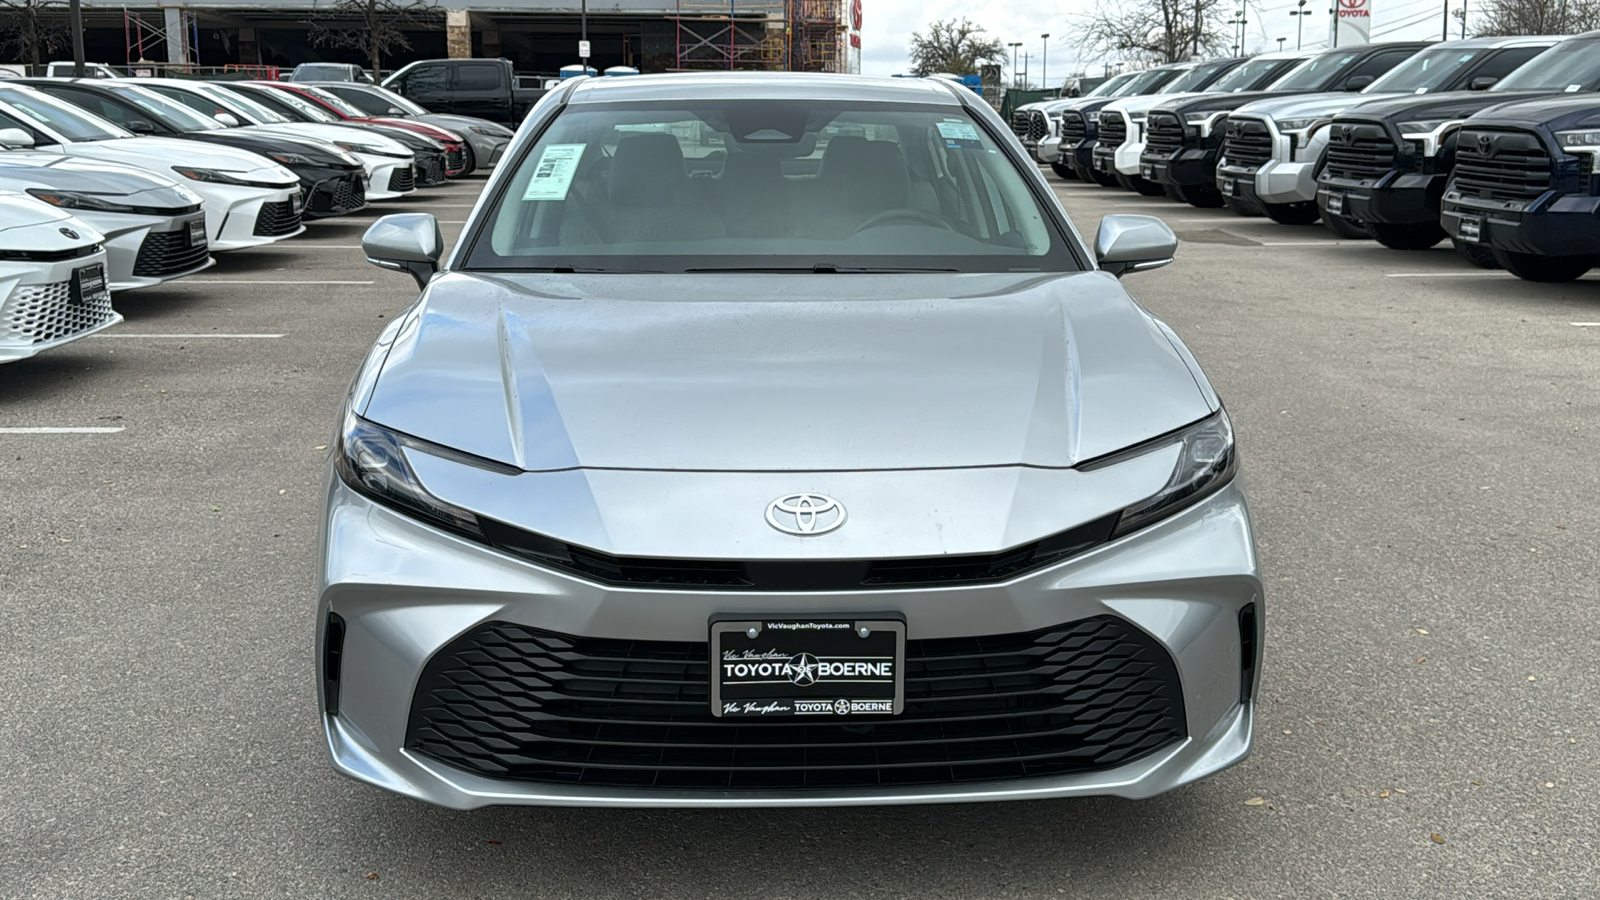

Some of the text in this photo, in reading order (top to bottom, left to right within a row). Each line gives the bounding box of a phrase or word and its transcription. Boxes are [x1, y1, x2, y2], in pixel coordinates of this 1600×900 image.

[1337, 9, 1370, 18] OYOTA
[767, 622, 850, 631] VicVaughanToyota.com
[722, 648, 788, 661] Vic Vaughan
[723, 663, 793, 677] TOYOTA
[818, 662, 892, 676] BOERNE
[723, 701, 740, 714] Vic
[743, 701, 791, 714] Vaughan
[794, 703, 833, 711] TOYOTA
[851, 703, 892, 711] BOERNE
